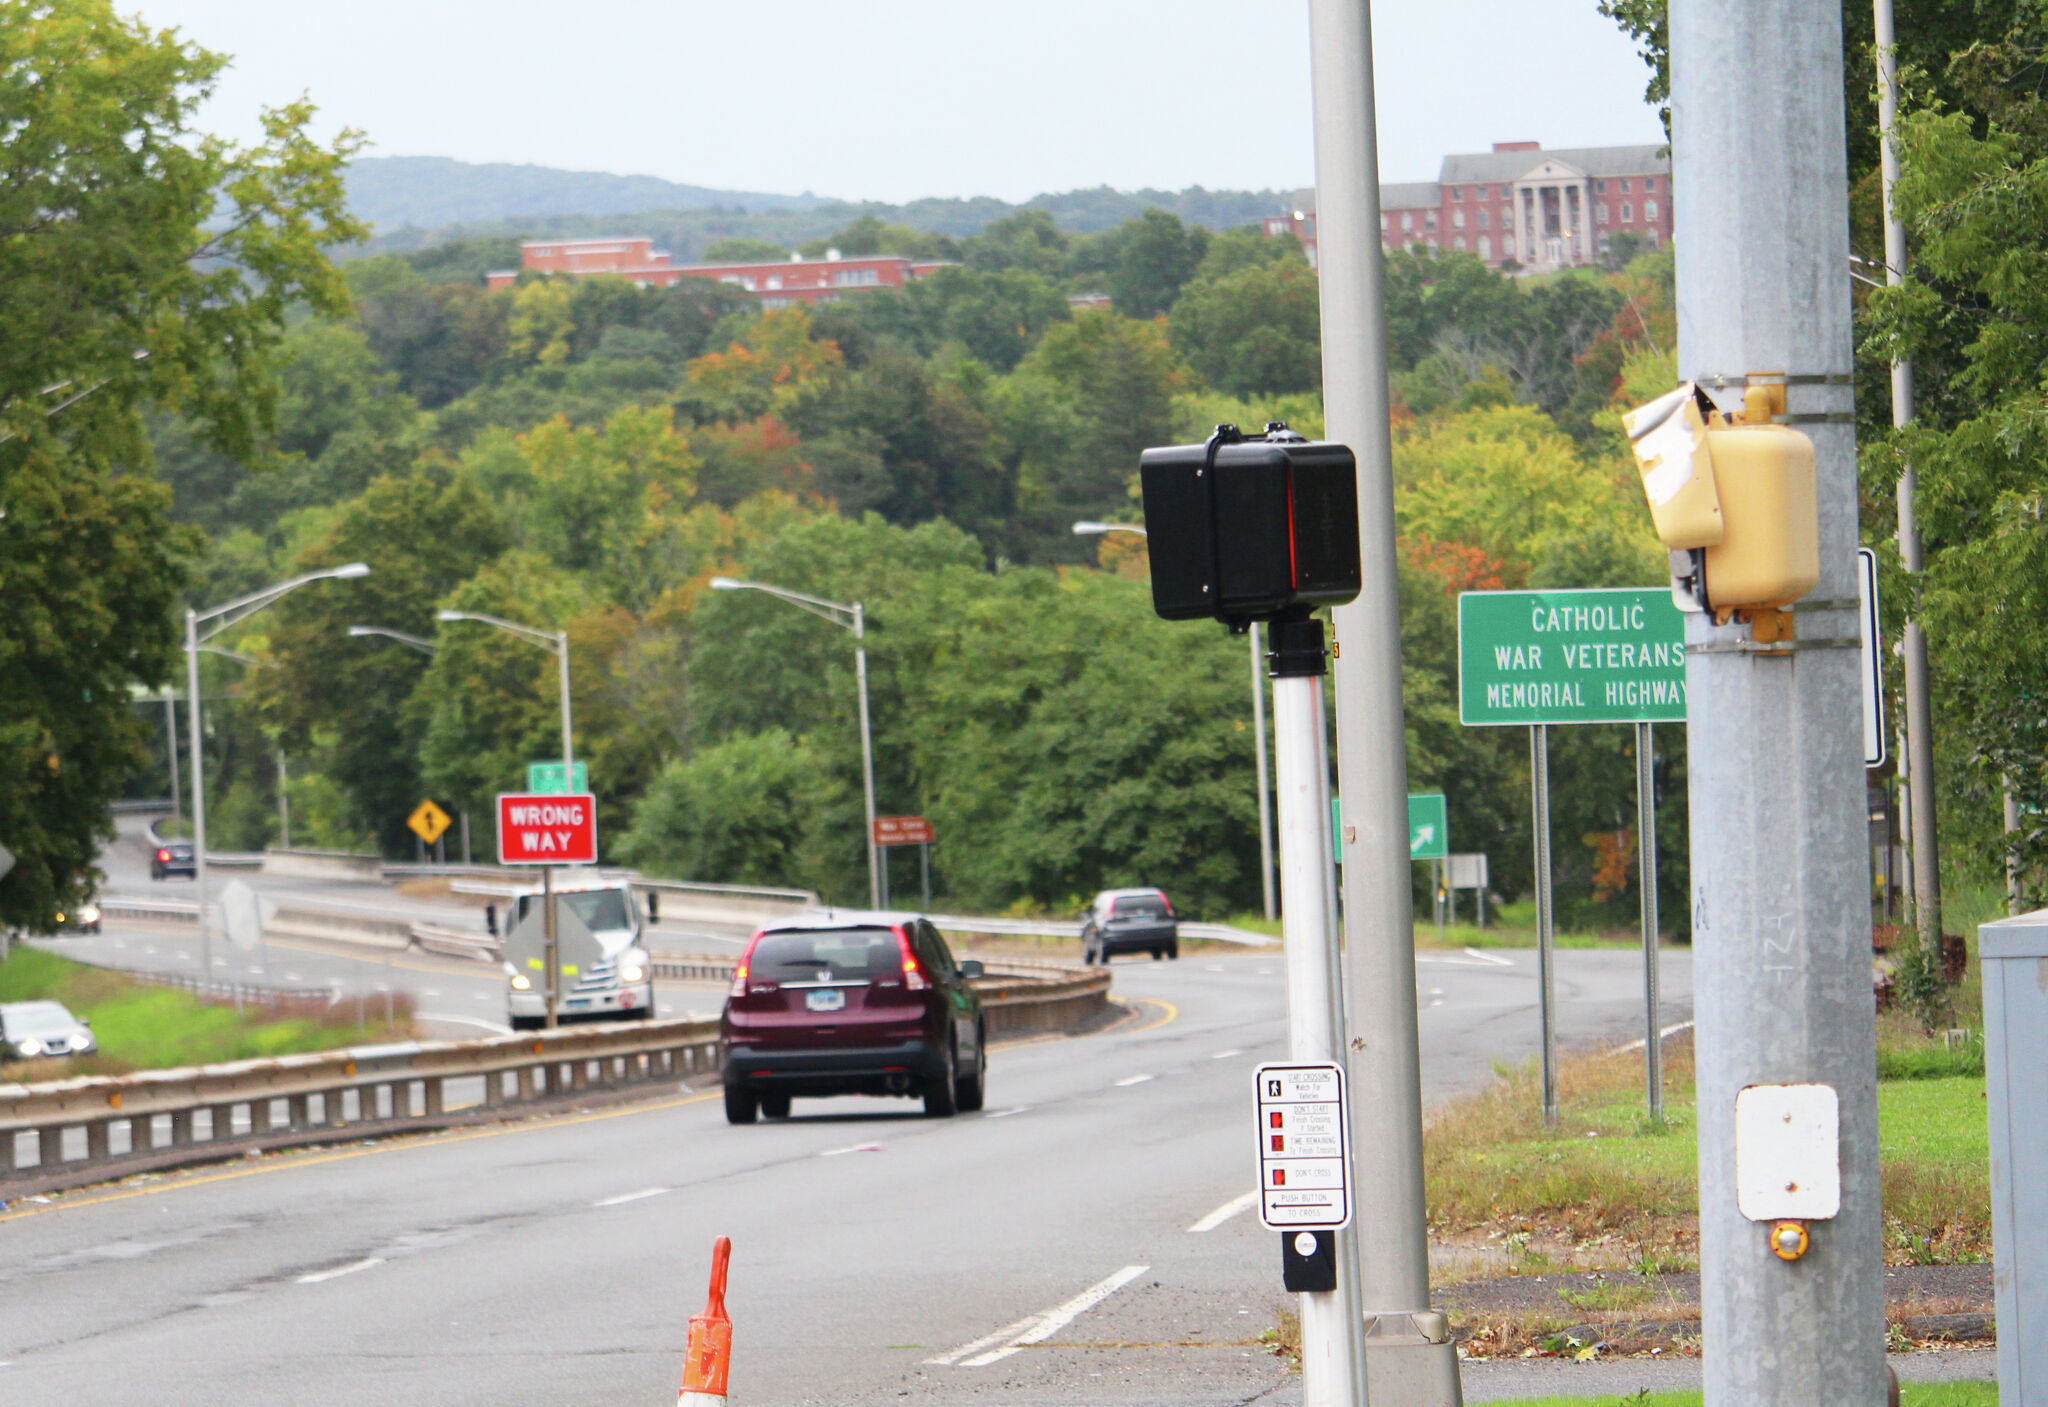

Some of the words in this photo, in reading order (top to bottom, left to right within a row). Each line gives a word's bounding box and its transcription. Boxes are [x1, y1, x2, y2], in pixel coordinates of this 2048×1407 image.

[1532, 606, 1645, 632] CATHOLIC
[1494, 645, 1543, 670] WAR
[1562, 643, 1685, 669] VETERANS
[1487, 682, 1585, 709] MEMORIAL
[510, 804, 584, 826] WRONG
[521, 831, 572, 852] WAY
[1314, 1169, 1331, 1177] CROSS
[1281, 1194, 1298, 1202] PUSH
[1302, 1193, 1327, 1202] BUTTON
[1288, 1209, 1296, 1217] TO
[1299, 1209, 1320, 1217] CROSS
